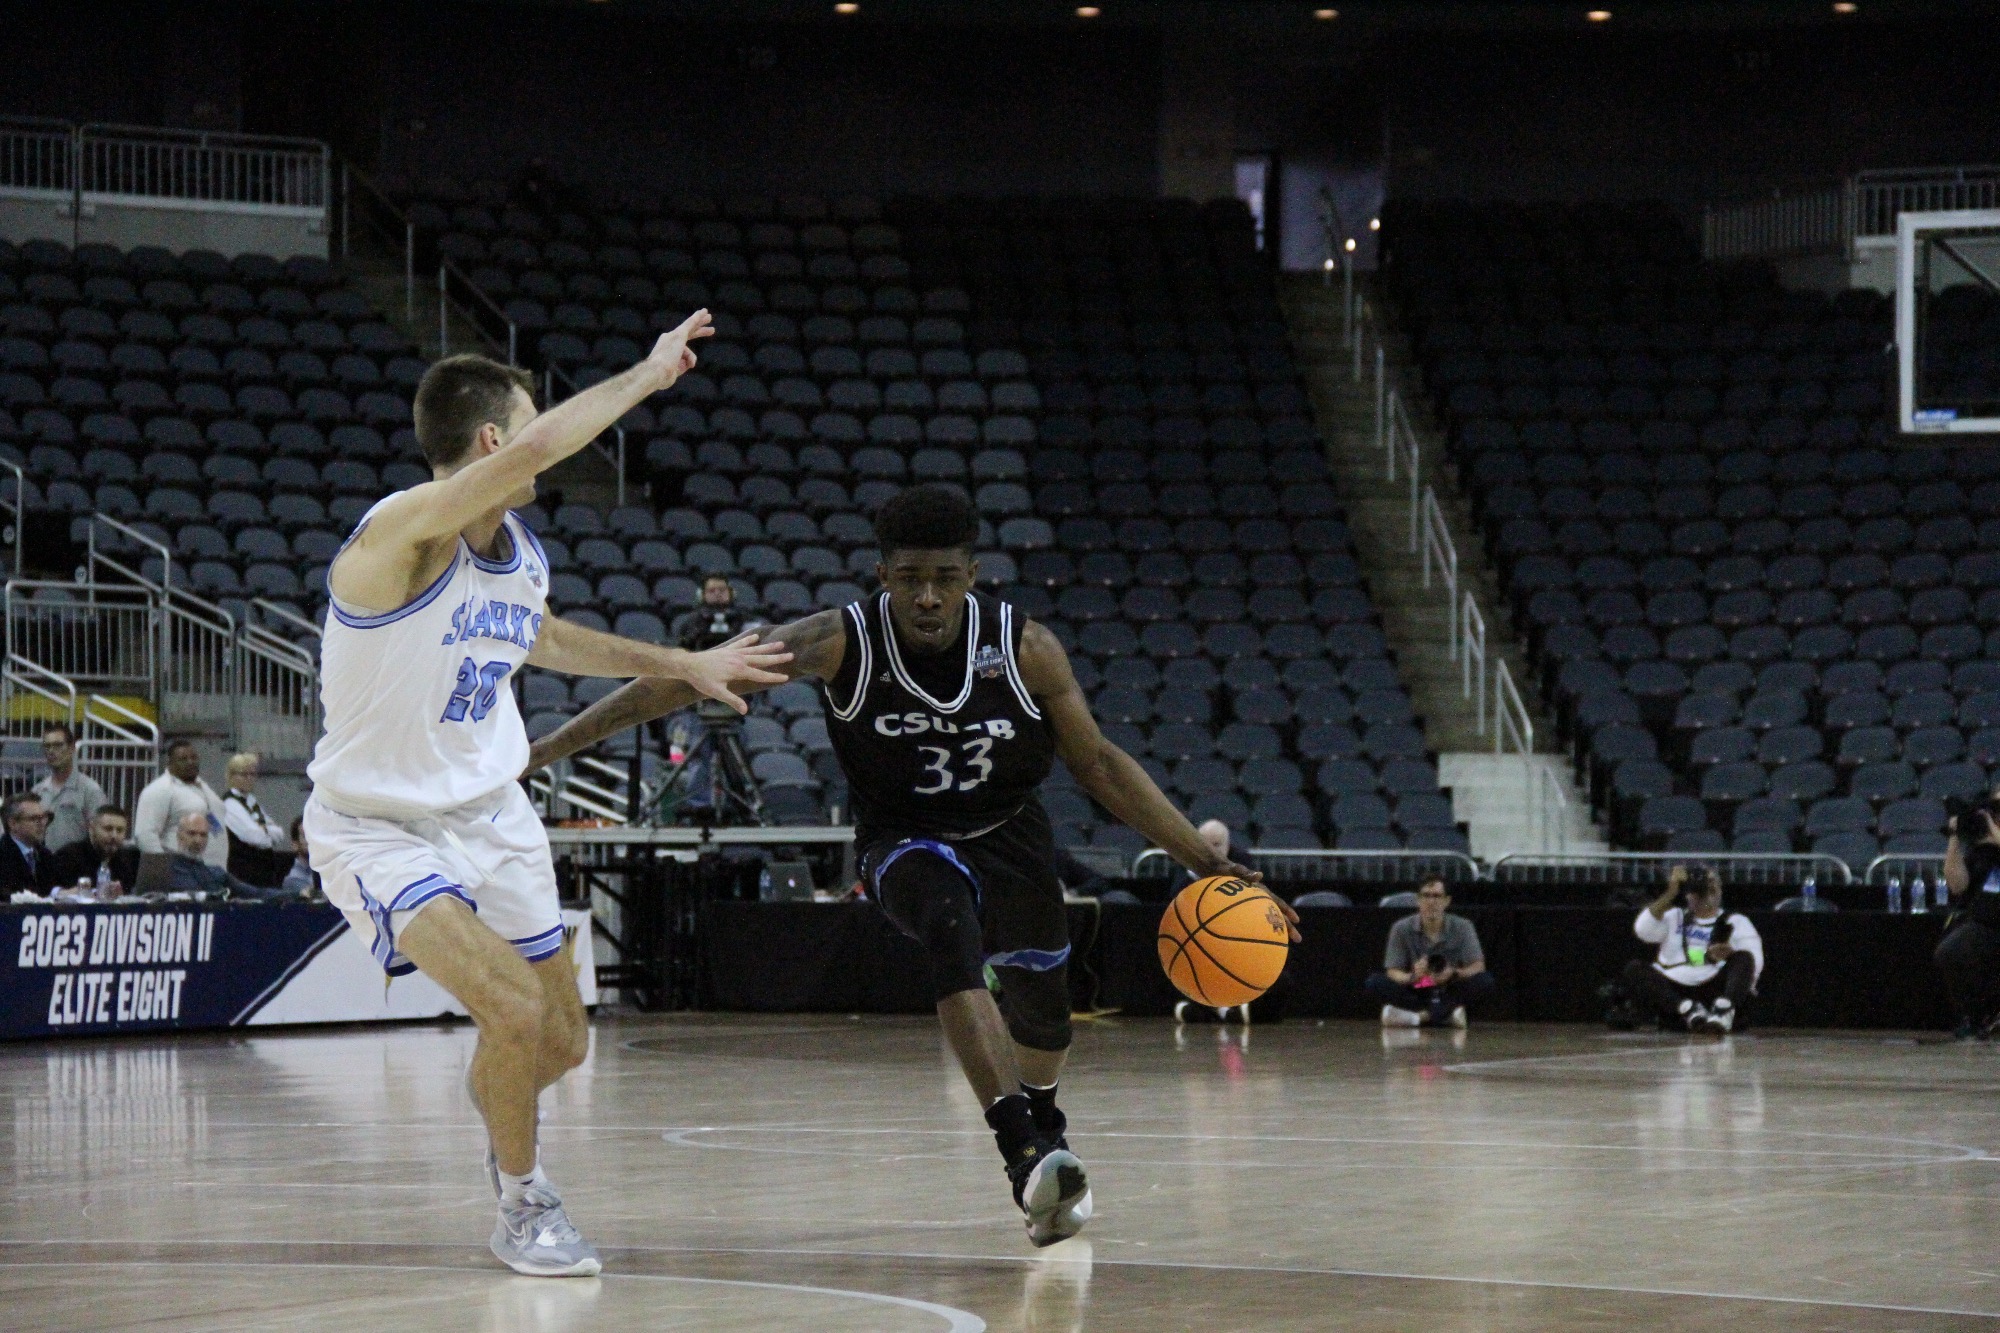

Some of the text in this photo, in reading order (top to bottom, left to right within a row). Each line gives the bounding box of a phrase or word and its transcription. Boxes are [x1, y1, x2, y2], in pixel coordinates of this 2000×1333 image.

[439, 656, 512, 723] 20
[914, 737, 993, 794] 33
[18, 912, 214, 967] 2023 DIVISION II
[48, 970, 186, 1024] ELITE EIGHT
